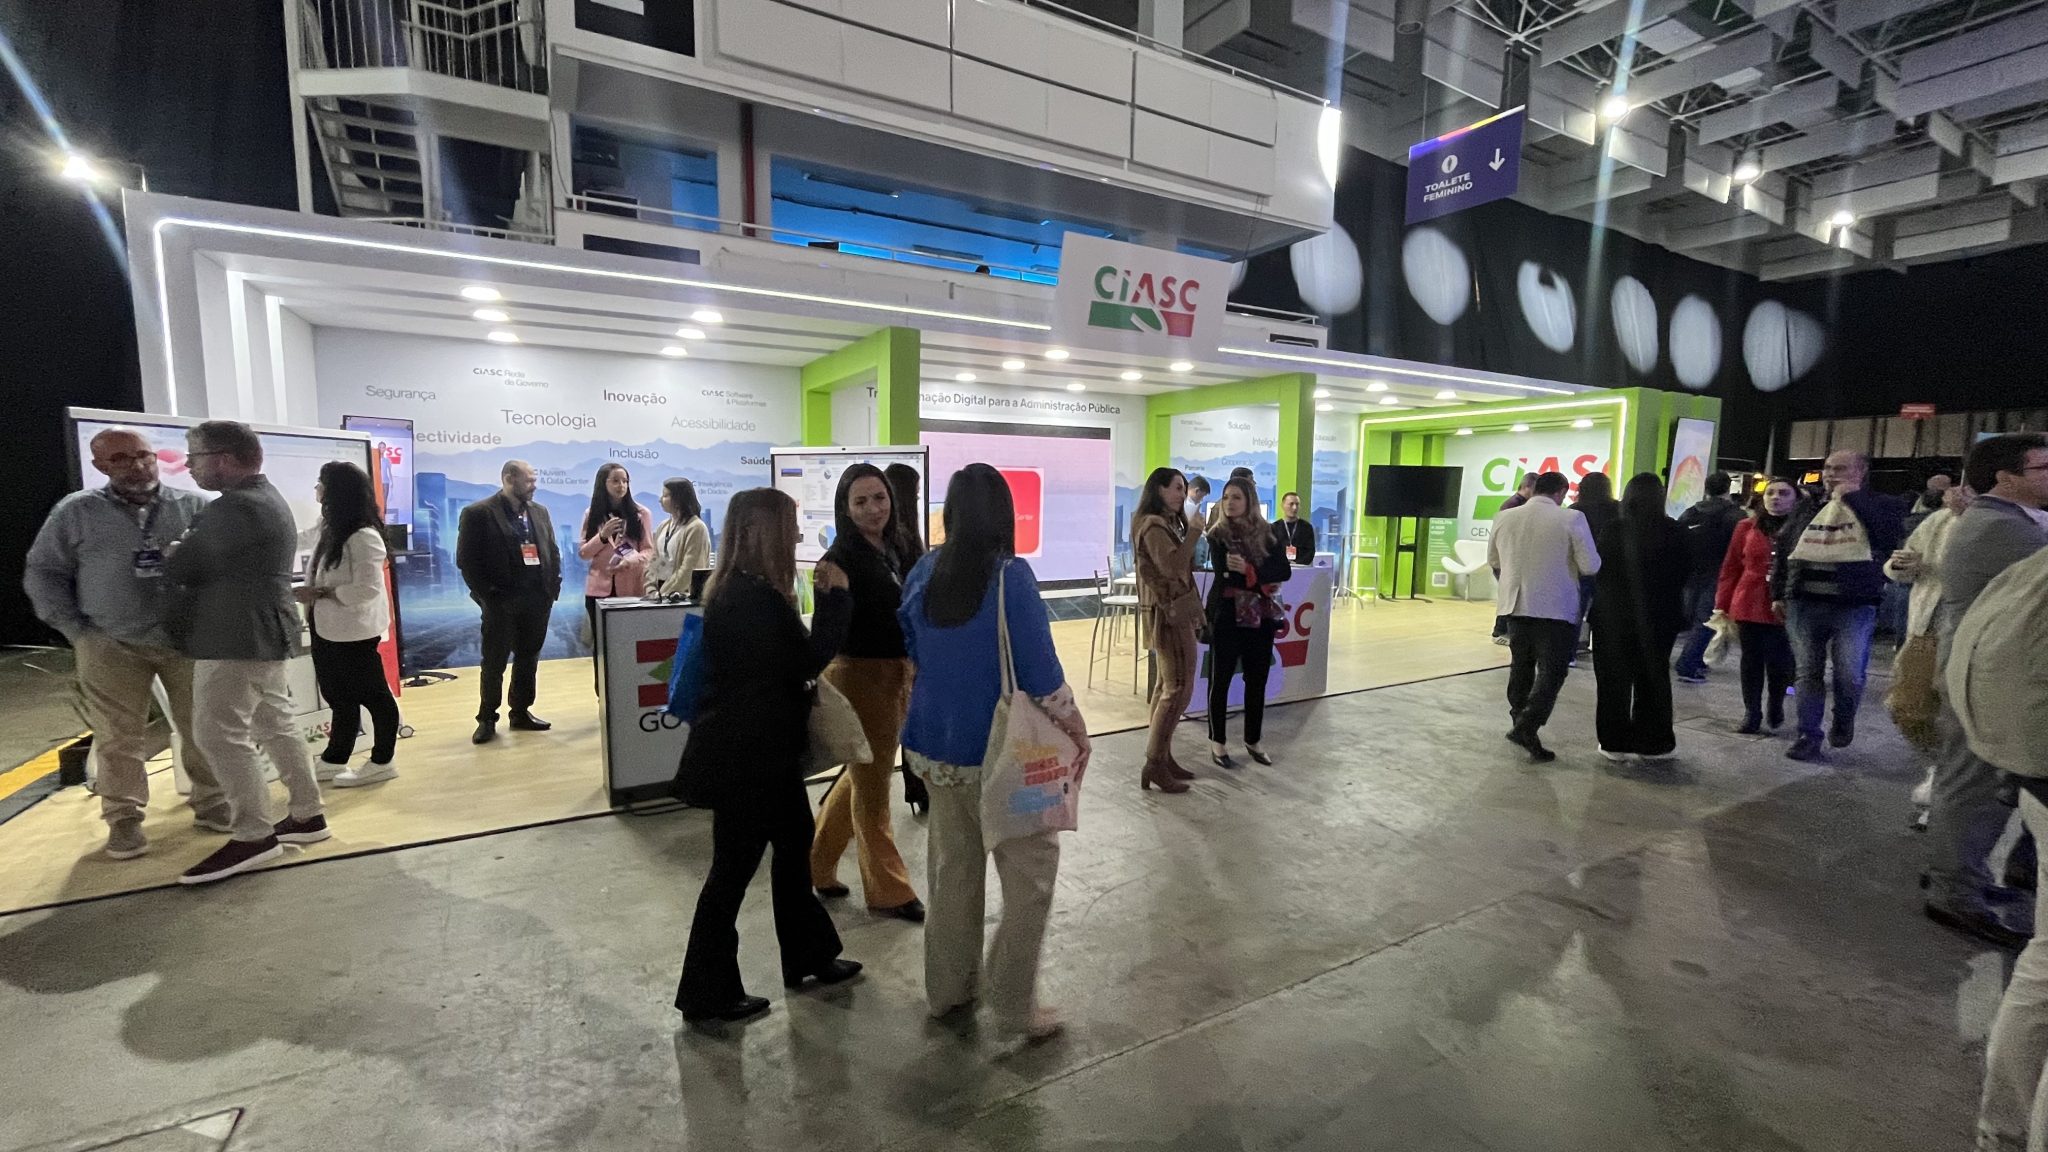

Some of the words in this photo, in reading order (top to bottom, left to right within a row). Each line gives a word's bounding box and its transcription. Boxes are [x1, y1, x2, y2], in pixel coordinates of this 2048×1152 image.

[1424, 172, 1471, 192] TOALETE
[1423, 181, 1473, 202] FEMININO
[366, 385, 436, 401] Segurança
[603, 389, 667, 406] Inovação
[953, 393, 986, 406] Digital
[988, 397, 1010, 408] para
[1020, 398, 1087, 414] Administração
[1088, 403, 1121, 414] Pública
[501, 409, 597, 429] Tecnologia
[671, 416, 756, 431] Acessibilidade
[1227, 421, 1251, 431] Solução
[413, 430, 502, 445] ectividade
[609, 448, 659, 460] Inclusão
[740, 456, 771, 465] Saúde
[1471, 527, 1491, 537] CEN
[639, 711, 682, 733] GO
